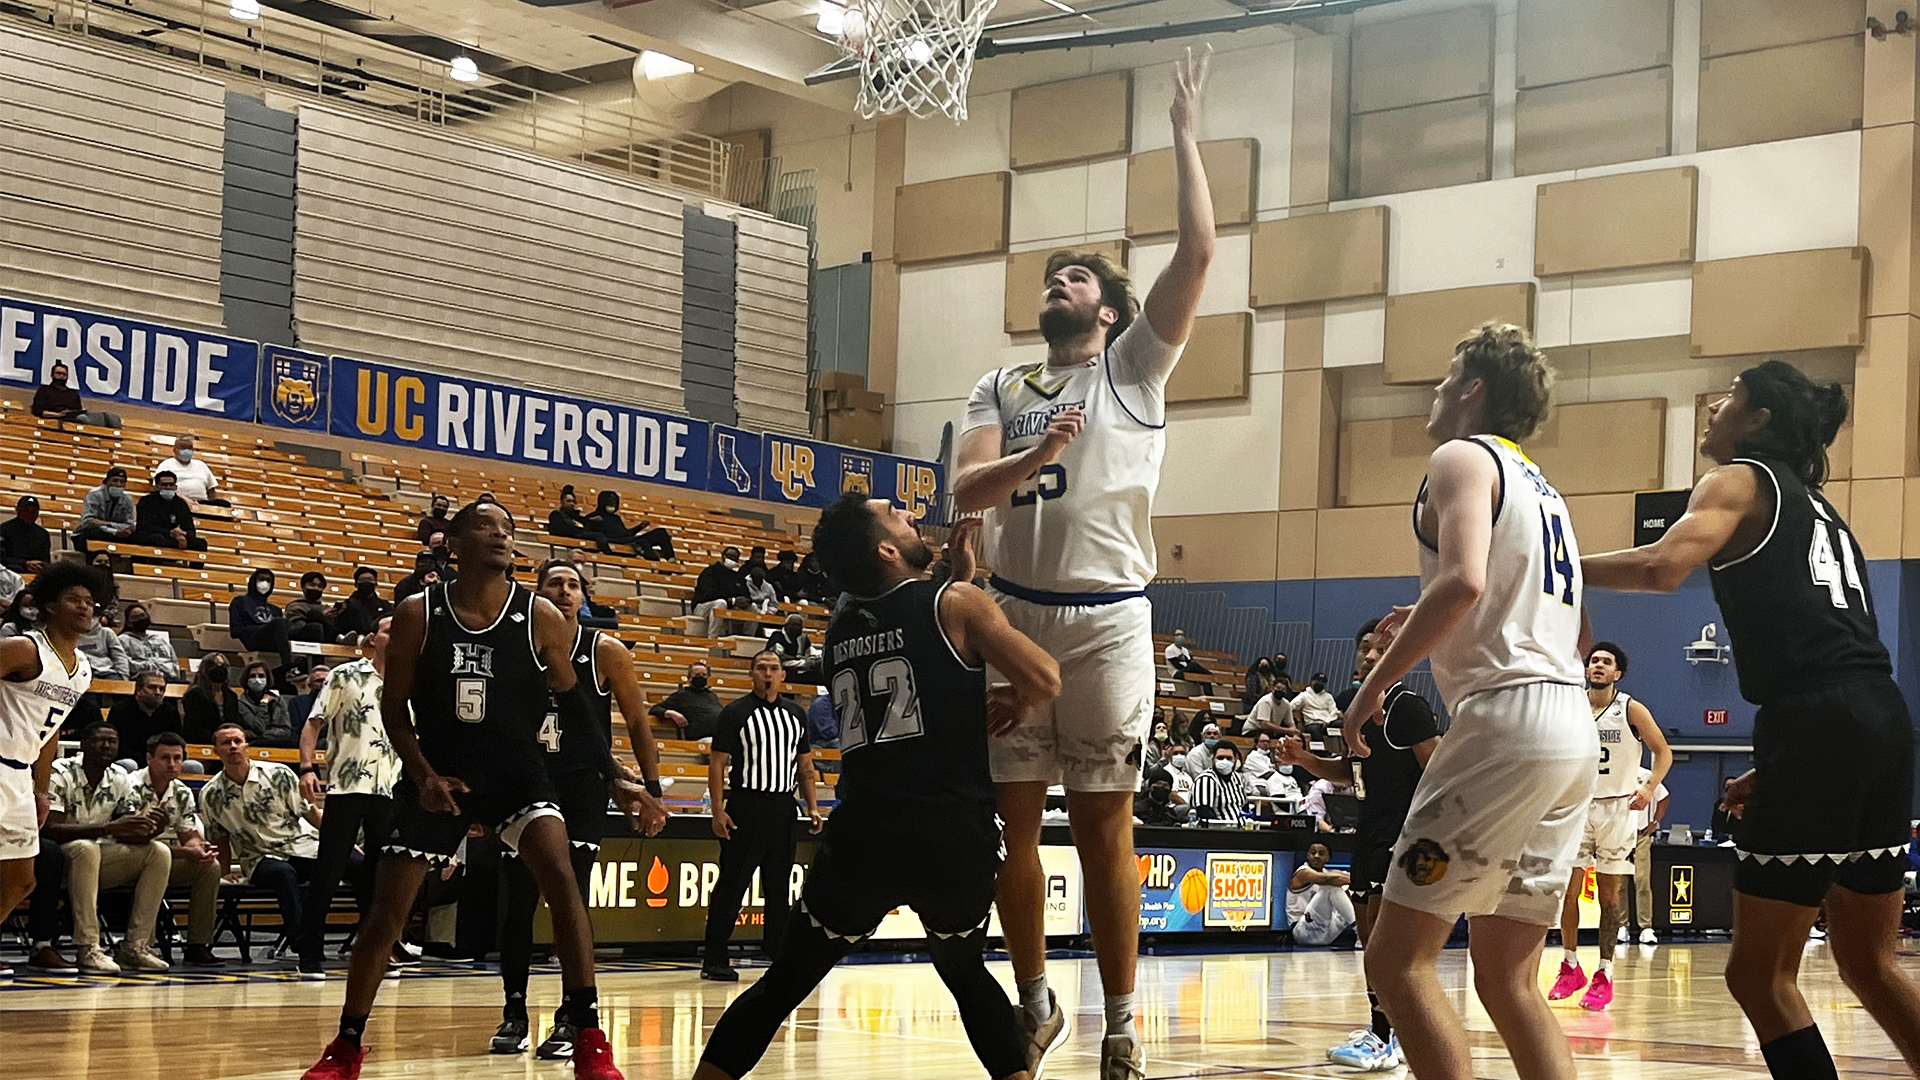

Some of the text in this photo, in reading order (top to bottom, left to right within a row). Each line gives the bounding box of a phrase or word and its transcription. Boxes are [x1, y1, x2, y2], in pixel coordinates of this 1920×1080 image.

[356, 368, 689, 483] UC RIVERSIDE
[1643, 518, 1665, 528] HOME
[1540, 502, 1574, 608] 14
[833, 628, 905, 666] DESROSIERS
[456, 678, 487, 723] 5
[832, 656, 925, 755] 22
[1707, 710, 1726, 724] EXIT
[1214, 863, 1263, 875] TAKE YOUR
[1214, 878, 1262, 898] SHOT!
